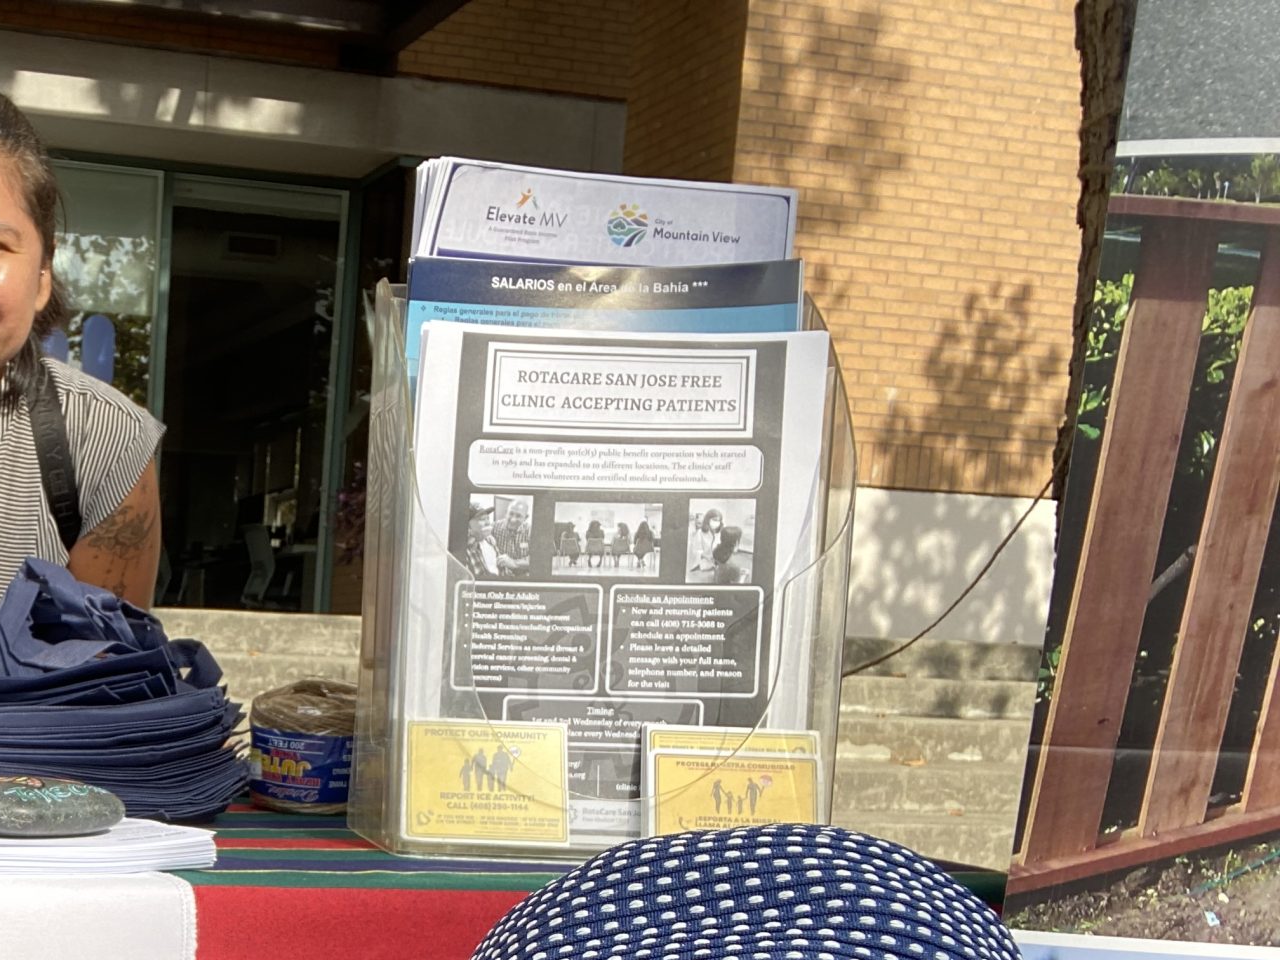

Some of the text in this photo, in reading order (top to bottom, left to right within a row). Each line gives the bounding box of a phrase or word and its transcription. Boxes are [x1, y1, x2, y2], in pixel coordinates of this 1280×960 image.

[485, 205, 568, 229] Elevate MV
[654, 218, 666, 226] City
[653, 227, 741, 245] Mountain View
[491, 276, 689, 294] SALARIOS en el Área la Bahía
[517, 369, 722, 389] ROTACARE SAN JOSE FREE
[501, 393, 737, 413] CLINIC ACCEPTING PATIENTS
[479, 445, 514, 455] RotaCare
[528, 446, 565, 457] non-profit
[599, 448, 621, 460] public
[623, 448, 649, 457] benefit
[650, 450, 694, 461] corporation
[696, 449, 719, 458] which
[720, 450, 747, 458] started
[492, 458, 500, 466] in
[519, 458, 532, 467] and
[534, 459, 546, 467] has
[547, 459, 581, 470] expanded
[601, 461, 633, 470] different
[672, 461, 686, 470] The
[715, 462, 732, 471] staff
[512, 470, 542, 480] includes
[543, 472, 580, 481] volunteers
[582, 472, 595, 481] and
[597, 472, 627, 482] certified
[629, 473, 657, 482] medical
[616, 594, 649, 603] Schedule
[663, 595, 714, 605] Appointment:
[649, 607, 663, 615] and
[665, 608, 701, 618] returning
[702, 608, 733, 618] patients
[646, 619, 660, 627] call
[716, 620, 725, 628] to
[630, 631, 663, 639] schedule
[676, 632, 726, 641] appointment.
[630, 643, 653, 652] Please
[655, 643, 674, 652] leave
[681, 644, 712, 652] detailed
[629, 657, 660, 665] message
[662, 656, 678, 664] with
[680, 658, 698, 666] your
[699, 657, 712, 665] full
[628, 668, 665, 676] telephone
[667, 669, 698, 677] number,
[700, 669, 715, 677] and
[586, 706, 614, 717] Timing:
[573, 718, 613, 728] Wednesday
[614, 718, 622, 727] of
[623, 720, 641, 729] every
[424, 728, 466, 737] PROTECT
[492, 731, 548, 740] COMMUNITY
[440, 791, 474, 800] REPORT
[477, 792, 490, 800] ICE
[446, 802, 468, 810] CALL
